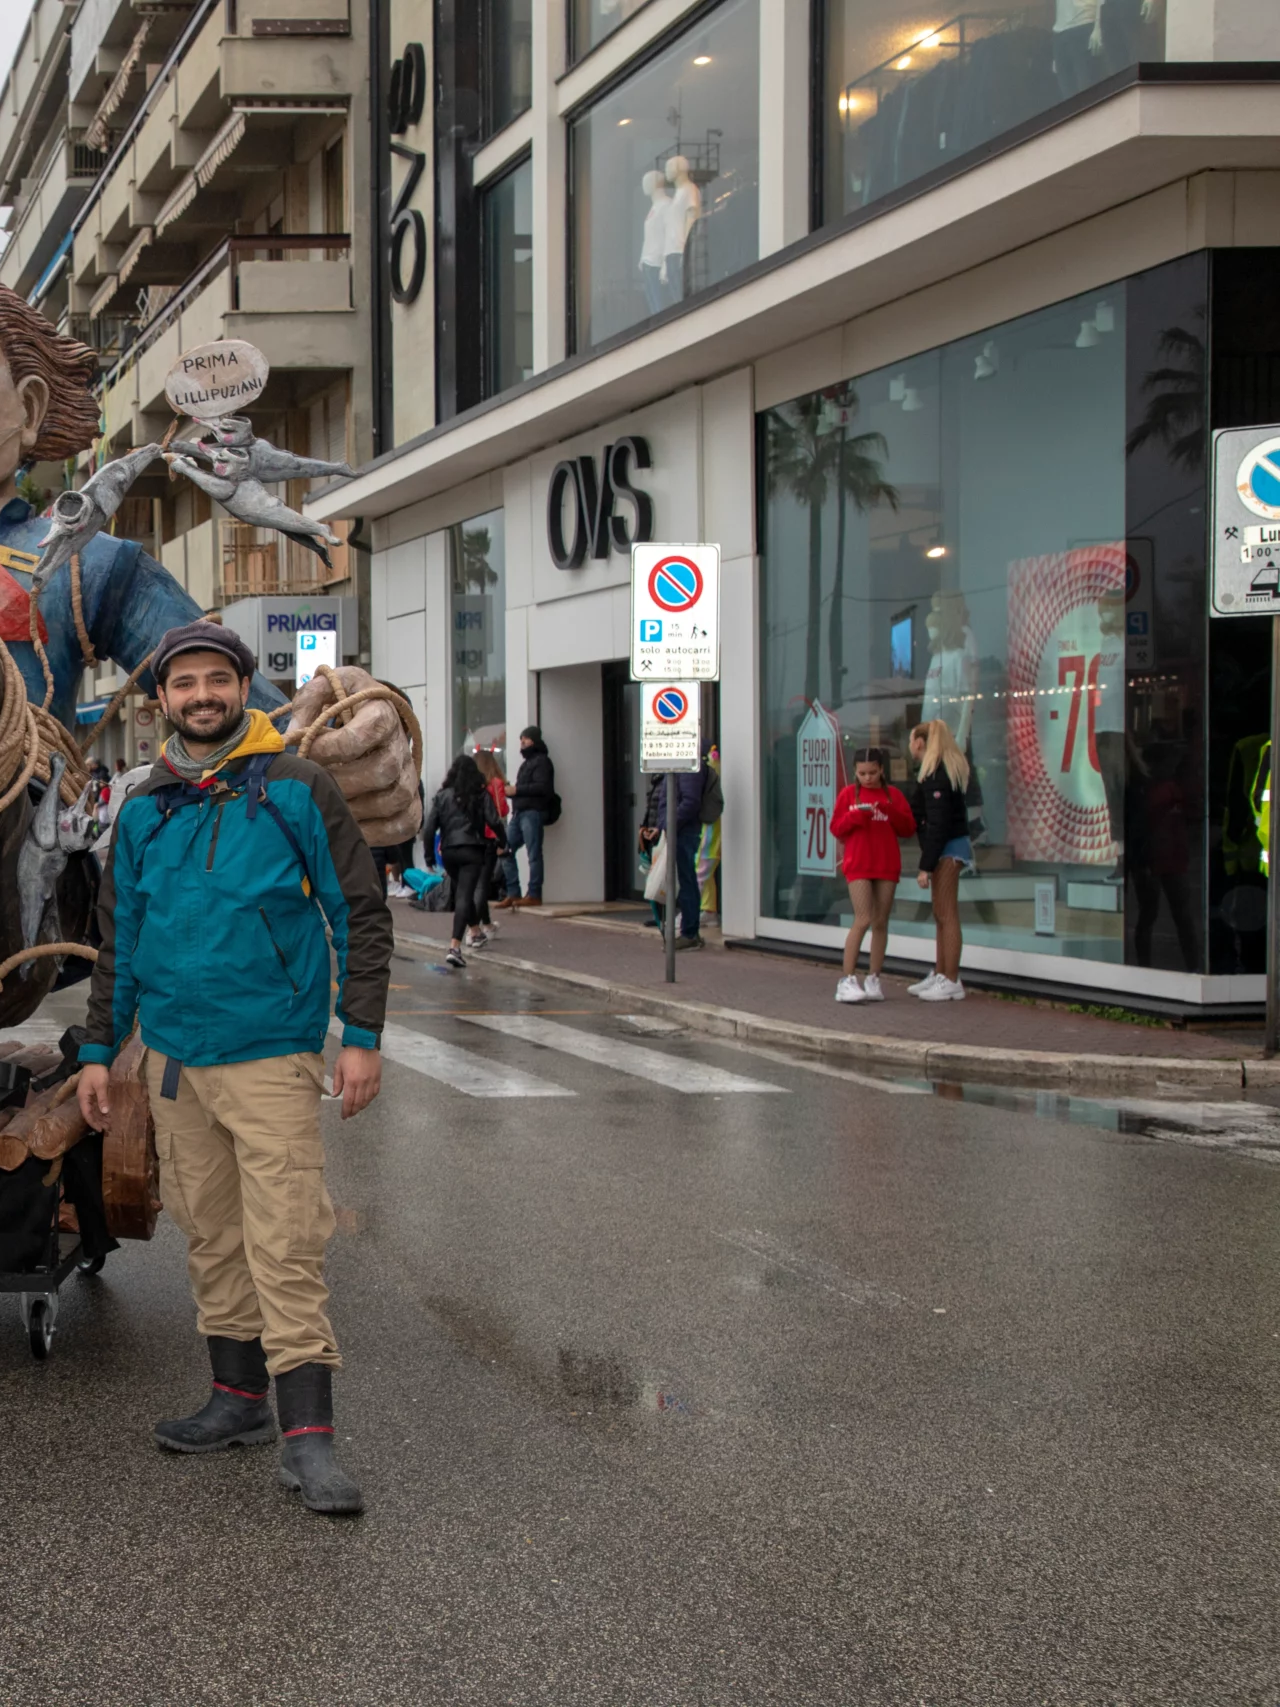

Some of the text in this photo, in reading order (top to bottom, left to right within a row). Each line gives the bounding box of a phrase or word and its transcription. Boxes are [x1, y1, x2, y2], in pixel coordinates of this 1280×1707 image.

[388, 42, 426, 306] OVS
[182, 351, 239, 373] PRIMA
[175, 377, 263, 406] LILLIPUZIANI
[547, 436, 654, 570] OVS
[1260, 527, 1280, 543] Lu
[267, 613, 337, 632] PRIMIGI
[645, 621, 660, 641] P
[640, 646, 661, 654] solo
[665, 646, 711, 654] autocarri
[268, 652, 295, 673] igi
[802, 738, 831, 762] FUORI
[802, 763, 831, 788] TUTTO
